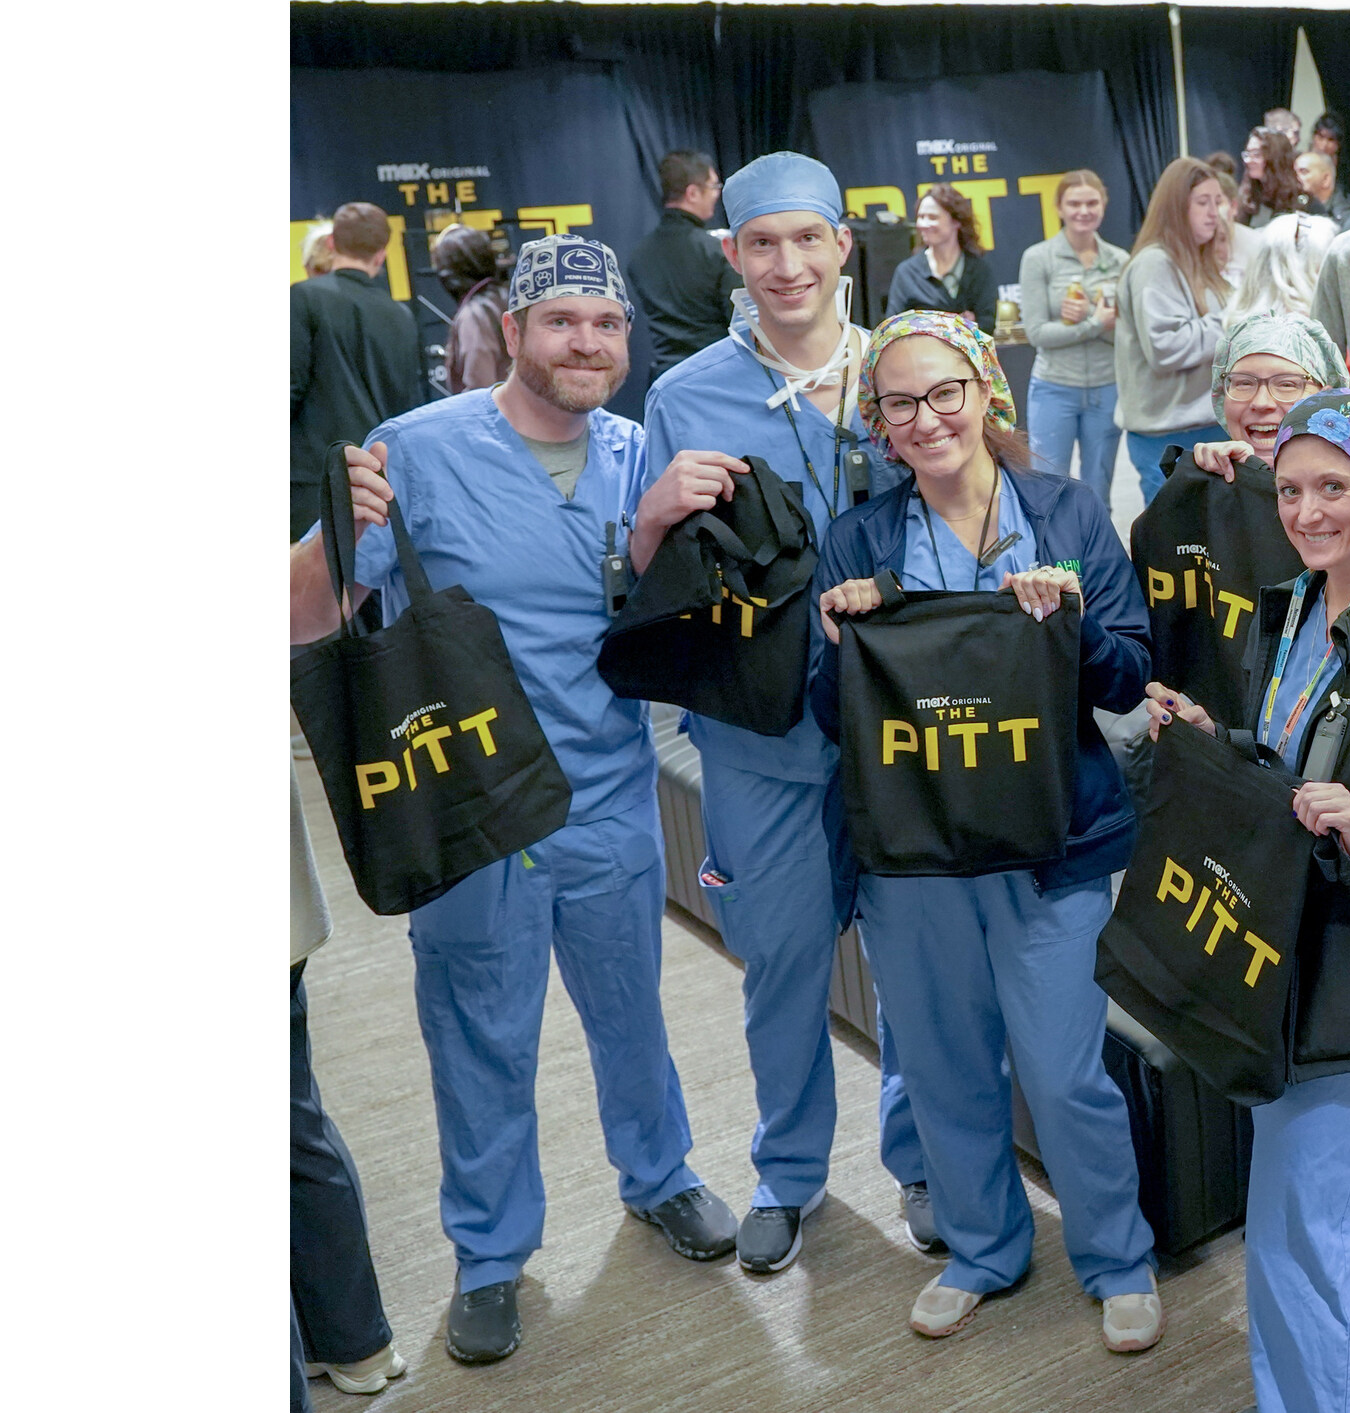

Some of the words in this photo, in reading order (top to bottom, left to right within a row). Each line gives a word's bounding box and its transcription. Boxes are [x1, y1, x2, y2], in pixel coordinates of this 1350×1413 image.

[930, 154, 989, 176] THE
[398, 180, 478, 206] THE
[582, 274, 603, 283] STATE
[1176, 544, 1208, 556] max
[409, 701, 447, 721] ORIGINAL
[917, 695, 950, 710] max
[951, 697, 992, 706] ORIGINAL
[936, 706, 976, 721] THE
[405, 714, 434, 741] THE
[882, 717, 1040, 772] PITT
[355, 706, 498, 810] PITT
[1203, 856, 1230, 882] max
[1228, 880, 1252, 909] ORIGINAL
[1214, 877, 1239, 910] THE
[1156, 856, 1281, 988] PITT
